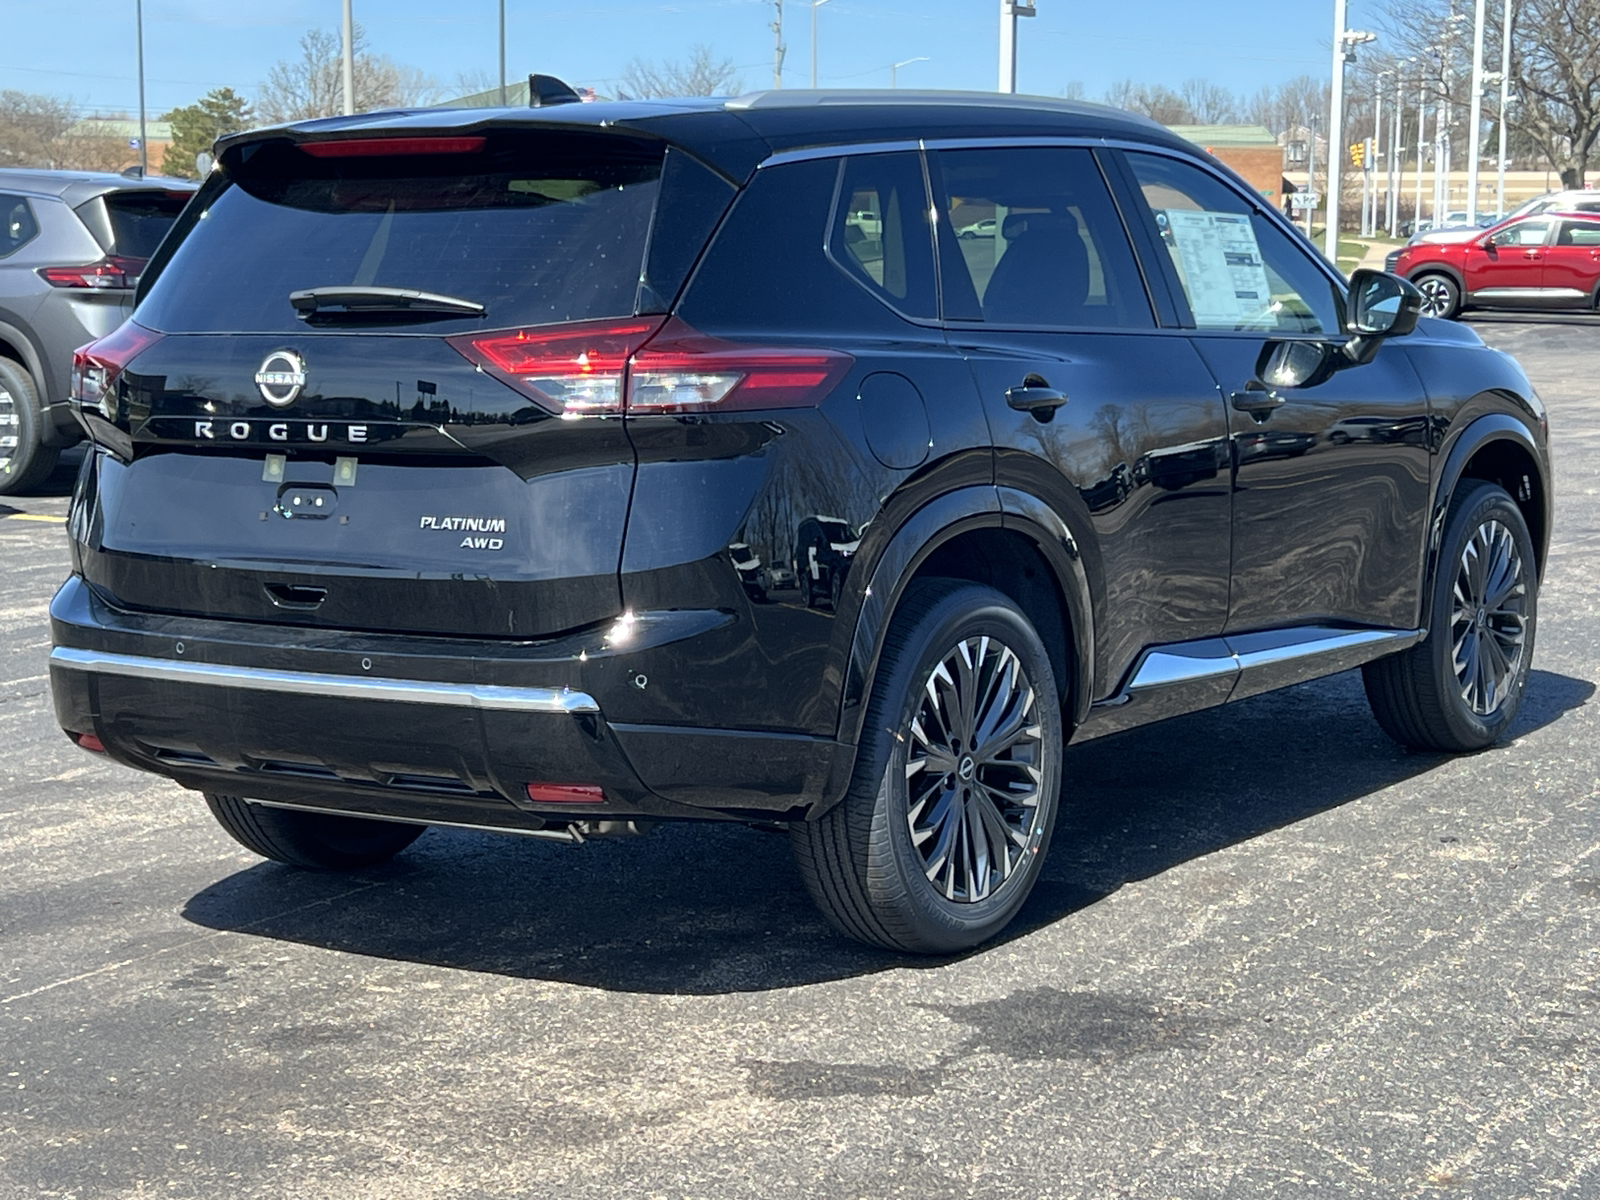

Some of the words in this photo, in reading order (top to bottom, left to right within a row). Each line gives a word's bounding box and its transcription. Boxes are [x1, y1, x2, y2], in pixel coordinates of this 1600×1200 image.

[255, 373, 305, 385] NISSAN
[195, 421, 368, 442] ROGUE
[420, 516, 506, 533] PLATINUM
[460, 537, 504, 550] AWD
